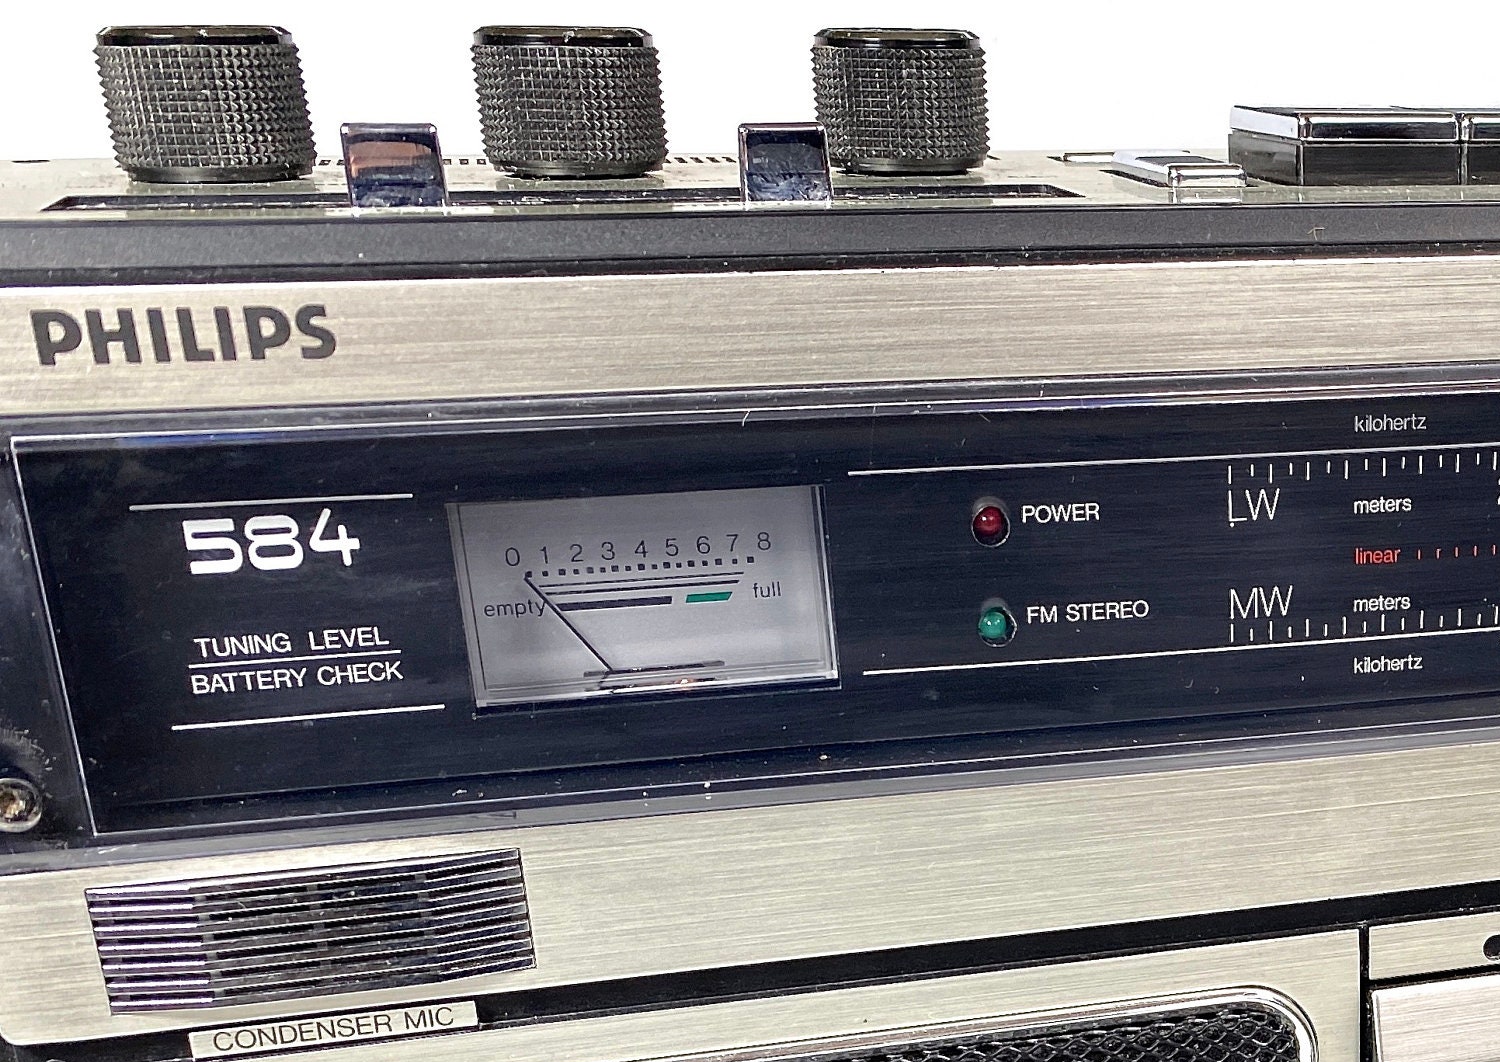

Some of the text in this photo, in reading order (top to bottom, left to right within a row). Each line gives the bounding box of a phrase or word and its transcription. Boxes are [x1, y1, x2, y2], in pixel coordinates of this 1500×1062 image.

[30, 303, 338, 366] PHILIPS
[1354, 413, 1427, 432] kilohertz
[1022, 503, 1100, 523] POWER
[1228, 488, 1280, 522] LW
[1353, 496, 1412, 513] meters
[182, 507, 361, 575] 584
[506, 531, 772, 565] 0 1 2 3 4 5 6 7 8
[1354, 547, 1400, 565] linear
[752, 579, 782, 599] full
[1230, 585, 1293, 619] MW
[1353, 595, 1411, 613] meters
[483, 595, 547, 620] empty
[1027, 600, 1149, 623] FM STEREO
[194, 625, 390, 659] TUNING LEVEL
[191, 659, 404, 694] BATTERY CHECK
[1353, 654, 1423, 675] kilohertz
[213, 1007, 454, 1051] CONDENSER MIC
